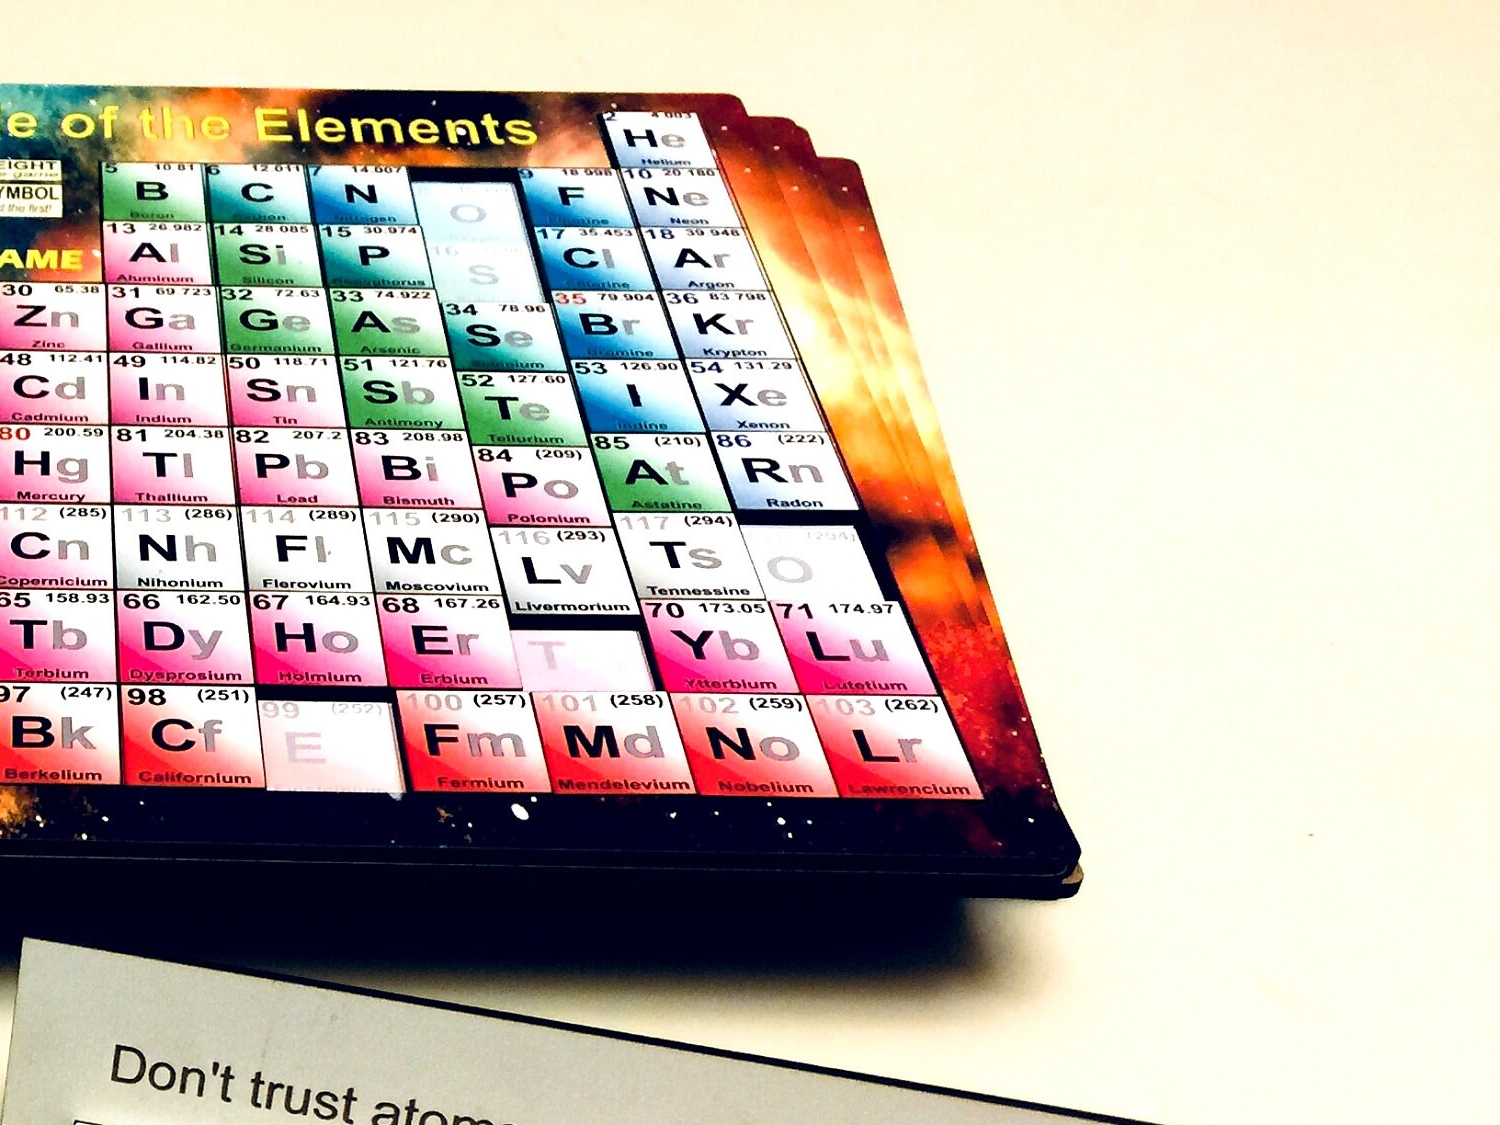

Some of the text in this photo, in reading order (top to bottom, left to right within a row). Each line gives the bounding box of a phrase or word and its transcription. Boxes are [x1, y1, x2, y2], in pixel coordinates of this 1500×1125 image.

[62, 107, 117, 141] of
[140, 107, 231, 140] the
[257, 108, 538, 147] Elements
[668, 293, 699, 304] 36
[693, 313, 754, 334] Kr
[0, 353, 102, 366] 48 112.41
[703, 348, 767, 358] Krypton
[114, 356, 216, 367] 49 114.82
[13, 375, 85, 399] Cd
[139, 377, 185, 400] In
[12, 412, 88, 421] Cadmium
[134, 412, 192, 425] Indium
[557, 531, 605, 542] (293)
[522, 557, 592, 584] Lv
[123, 594, 240, 609] 66 162.50
[516, 602, 630, 611] Livermorium
[776, 603, 894, 619] 71 174.97
[144, 621, 223, 660] Dy
[806, 631, 890, 661] Lu
[131, 669, 242, 681] Dysprosium
[824, 680, 907, 691] Lutetium
[110, 1045, 234, 1102] Don't
[250, 1071, 356, 1125] trust
